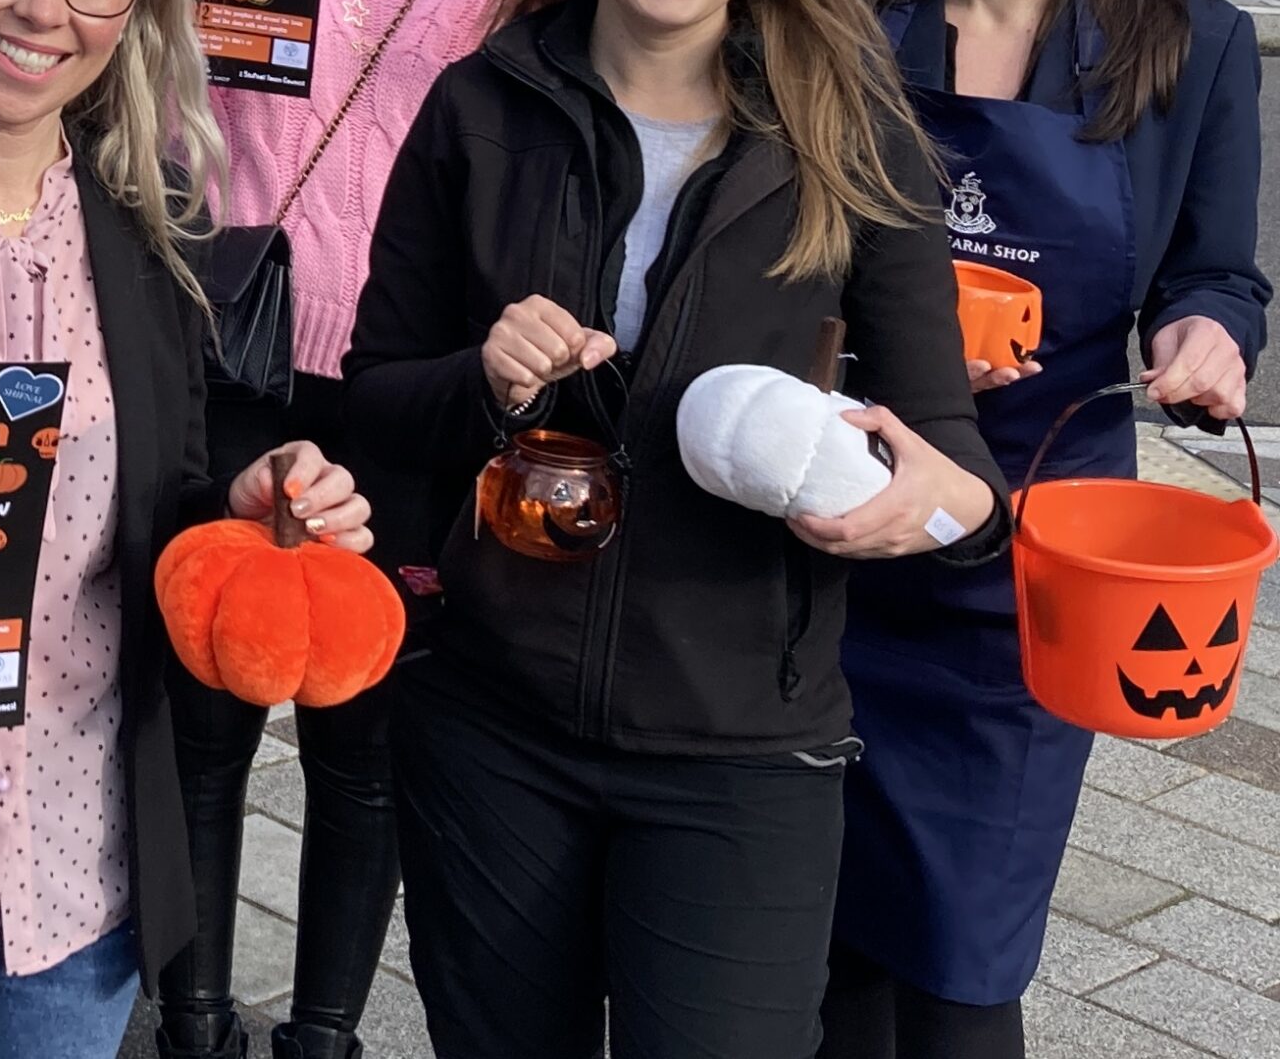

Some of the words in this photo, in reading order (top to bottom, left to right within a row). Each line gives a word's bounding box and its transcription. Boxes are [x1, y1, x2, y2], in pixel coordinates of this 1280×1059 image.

[202, 5, 210, 19] 2
[993, 244, 1040, 263] SHOP
[15, 381, 42, 394] LOVE
[4, 389, 44, 405] SHIFNAL
